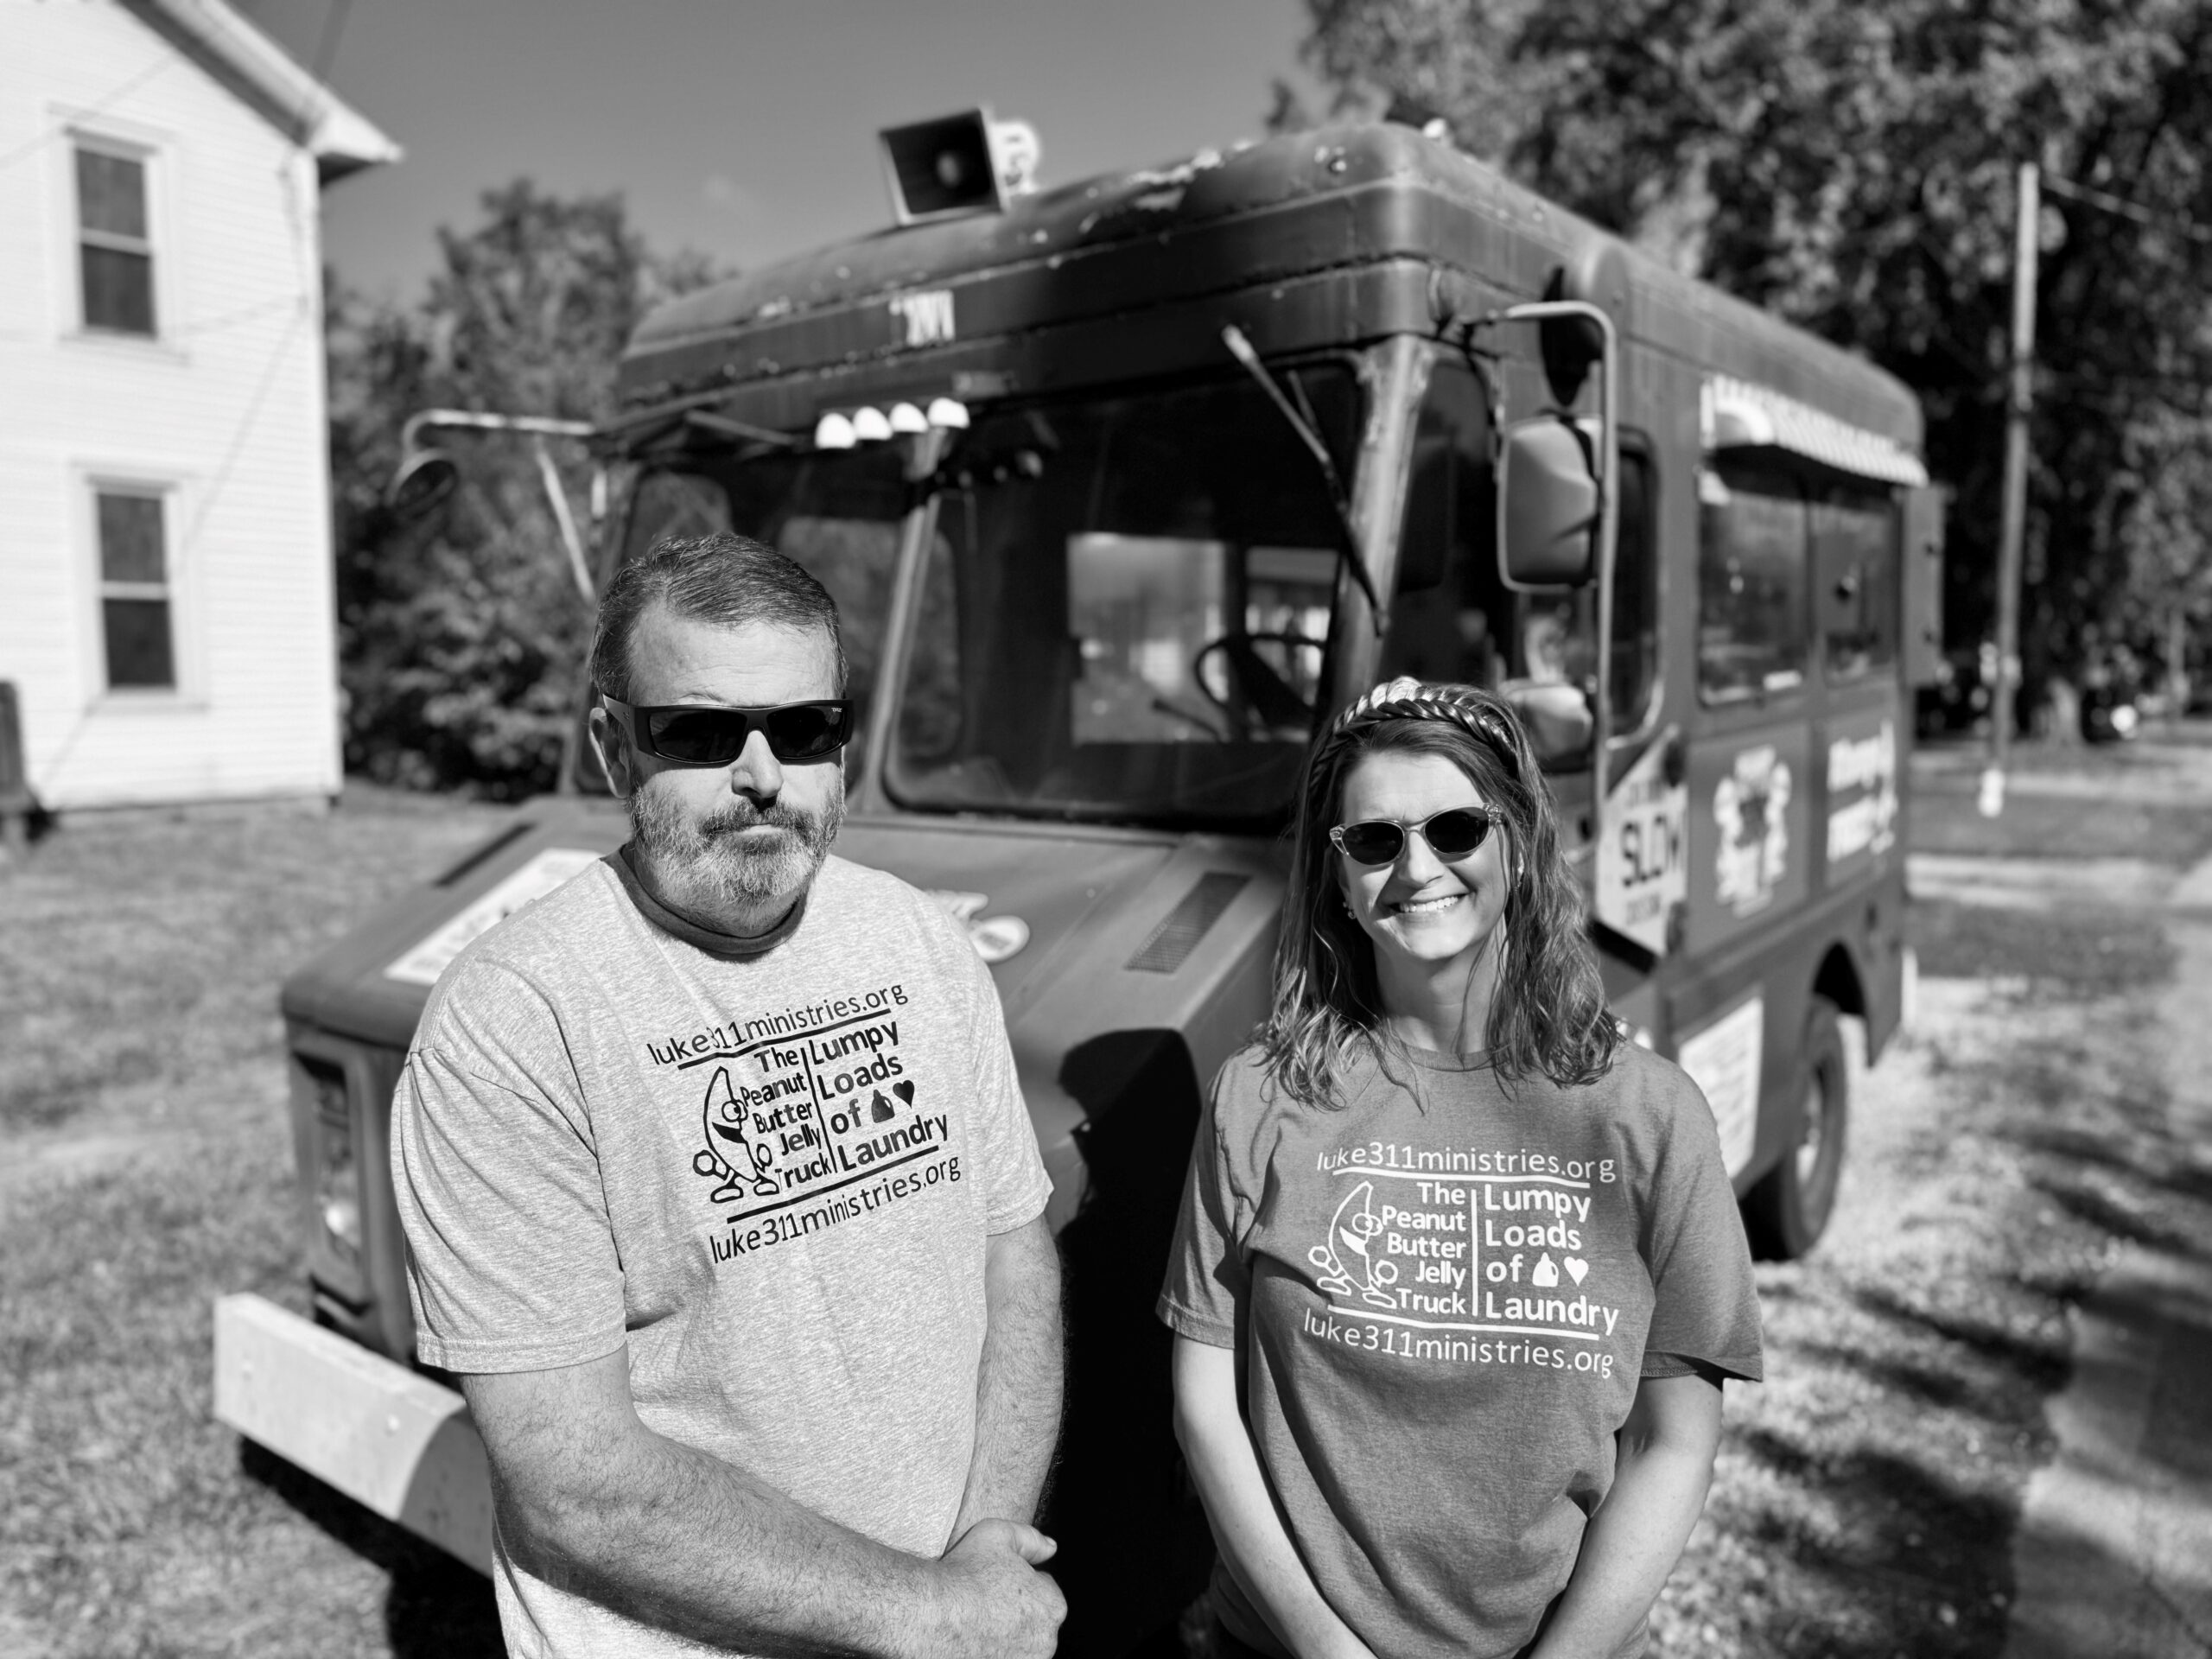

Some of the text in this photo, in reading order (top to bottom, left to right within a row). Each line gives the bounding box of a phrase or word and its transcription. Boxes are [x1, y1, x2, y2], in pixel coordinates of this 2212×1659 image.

[647, 984, 908, 1065] luke311ministries.org
[753, 1047, 799, 1072] The
[809, 1021, 899, 1065] Lumpy
[741, 1072, 807, 1106] Peanut
[817, 1053, 904, 1099] Loads
[753, 1101, 812, 1134] Butter
[830, 1099, 861, 1134] of
[780, 1123, 822, 1156] Jelly
[837, 1115, 948, 1171] Laundry
[774, 1154, 832, 1190] Truck
[1317, 1142, 1615, 1182] luke311ministries.org
[710, 1156, 961, 1263] luke311ministries.org
[1416, 1182, 1465, 1205] The
[1484, 1185, 1591, 1222] Lumpy
[1382, 1205, 1466, 1231] Peanut
[1486, 1220, 1581, 1249] Loads
[1388, 1232, 1466, 1258] Butter
[1415, 1262, 1466, 1288] Jelly
[1486, 1254, 1523, 1282] of
[1395, 1287, 1466, 1314] Truck
[1486, 1292, 1618, 1336] Laundry
[1305, 1308, 1613, 1378] luke311ministries.org
